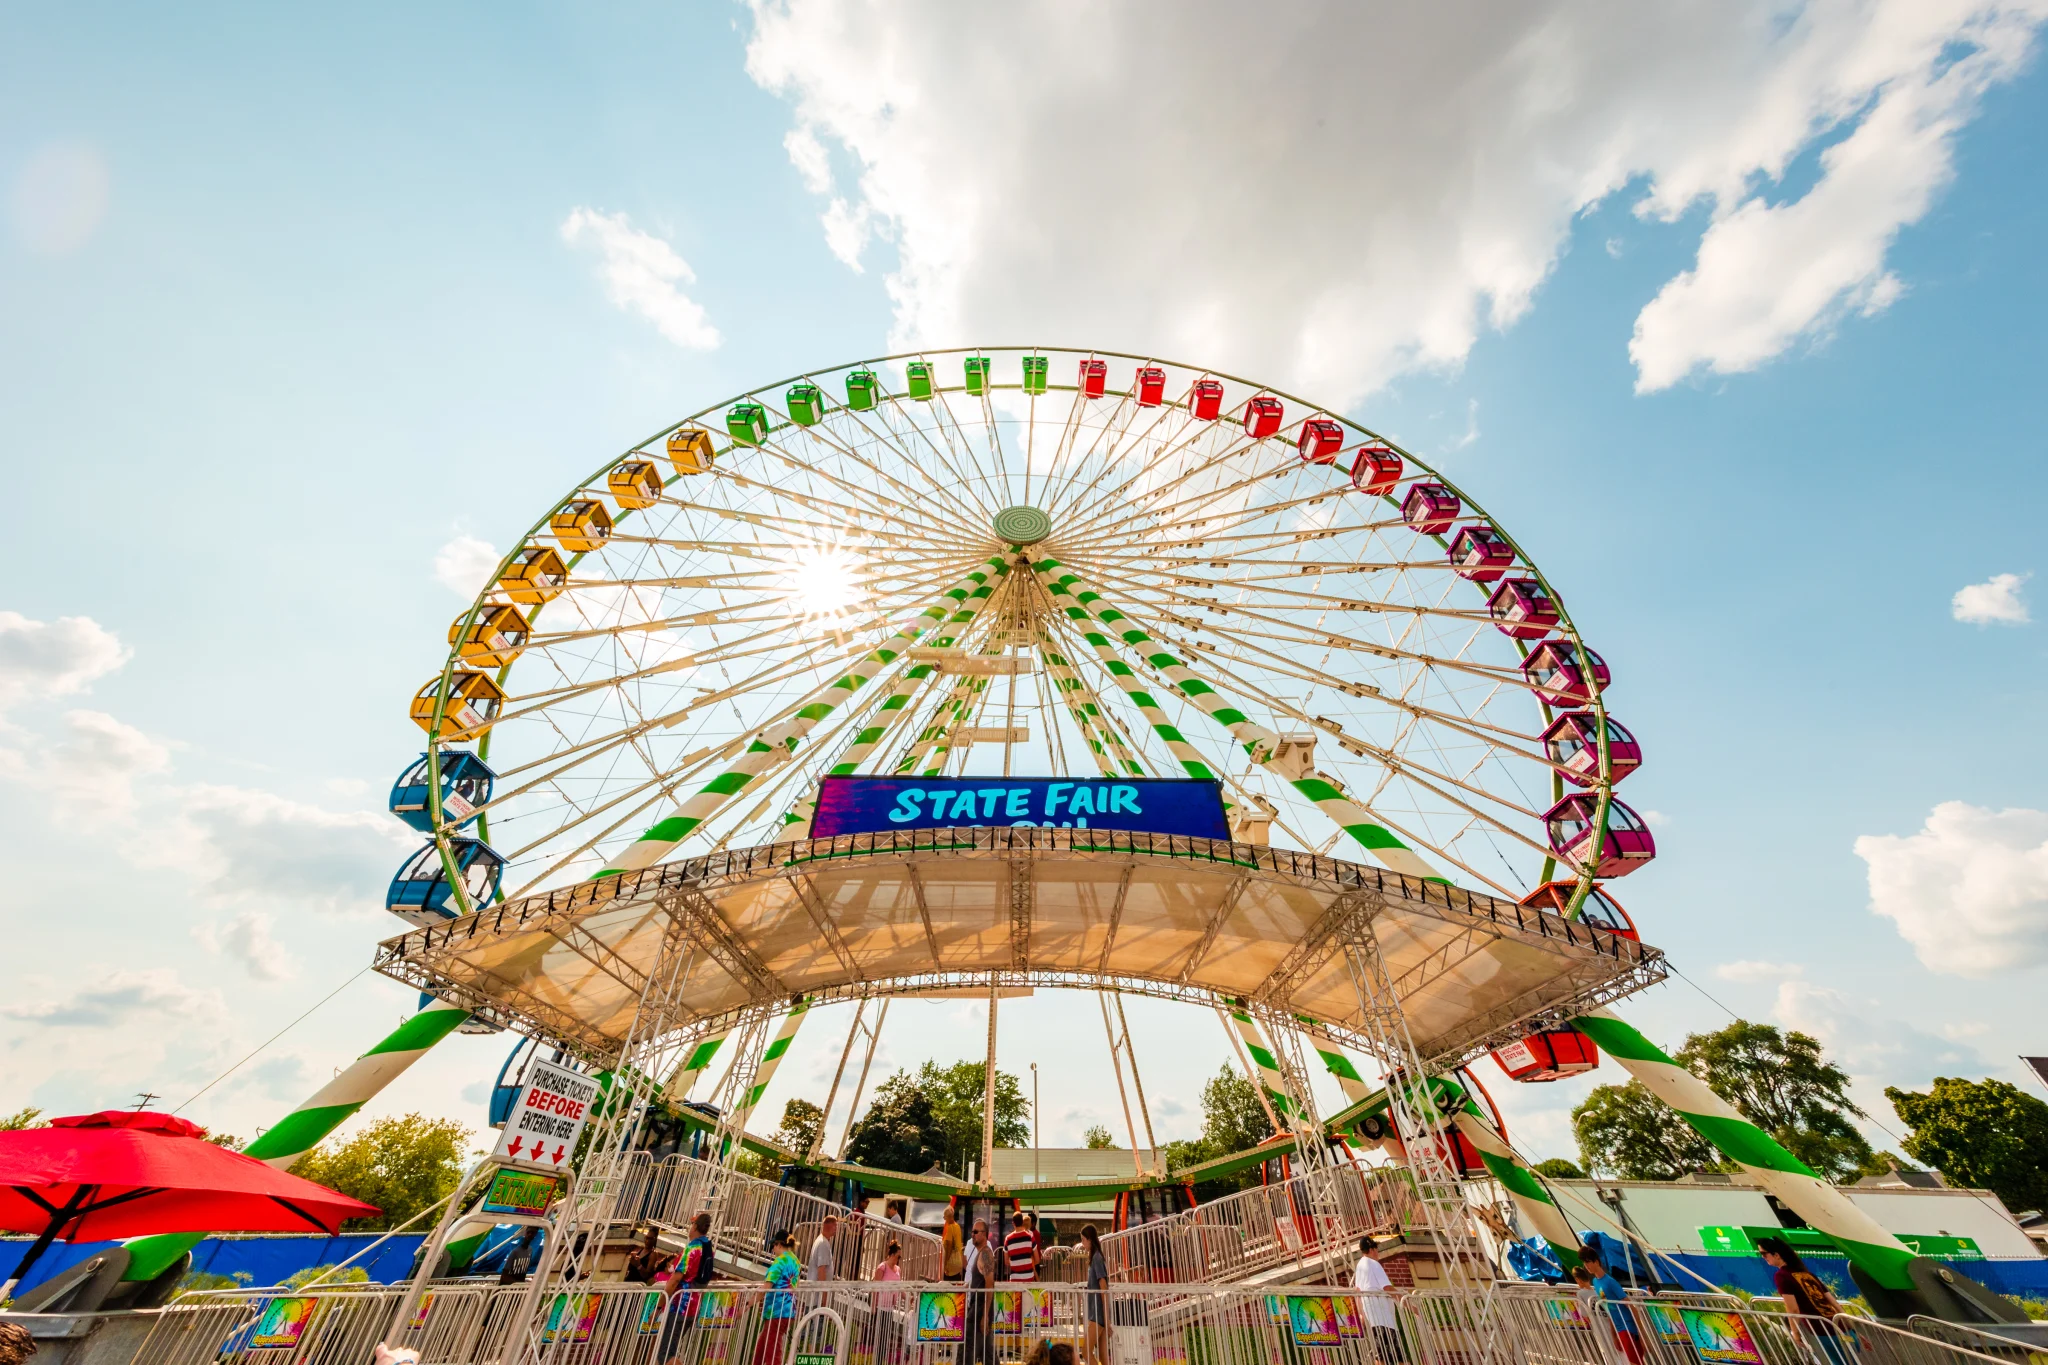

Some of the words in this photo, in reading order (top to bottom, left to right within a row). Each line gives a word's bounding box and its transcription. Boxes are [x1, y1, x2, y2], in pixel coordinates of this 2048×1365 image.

[888, 788, 1031, 822] STATE
[1044, 782, 1142, 815] FAIR
[531, 1068, 568, 1096] PURCHASE
[567, 1081, 595, 1103] TICKETS
[526, 1088, 585, 1120] BEFORE
[518, 1111, 556, 1135] ENTERING
[555, 1120, 575, 1140] HERE
[488, 1176, 552, 1211] ENTRANCE
[920, 1328, 939, 1339] Biggest
[939, 1328, 954, 1337] Wheel
[797, 1356, 808, 1365] CAN
[809, 1356, 820, 1365] YOU
[820, 1357, 833, 1365] RIDE
[1699, 1347, 1726, 1360] Biggest
[1726, 1349, 1748, 1361] Wheel
